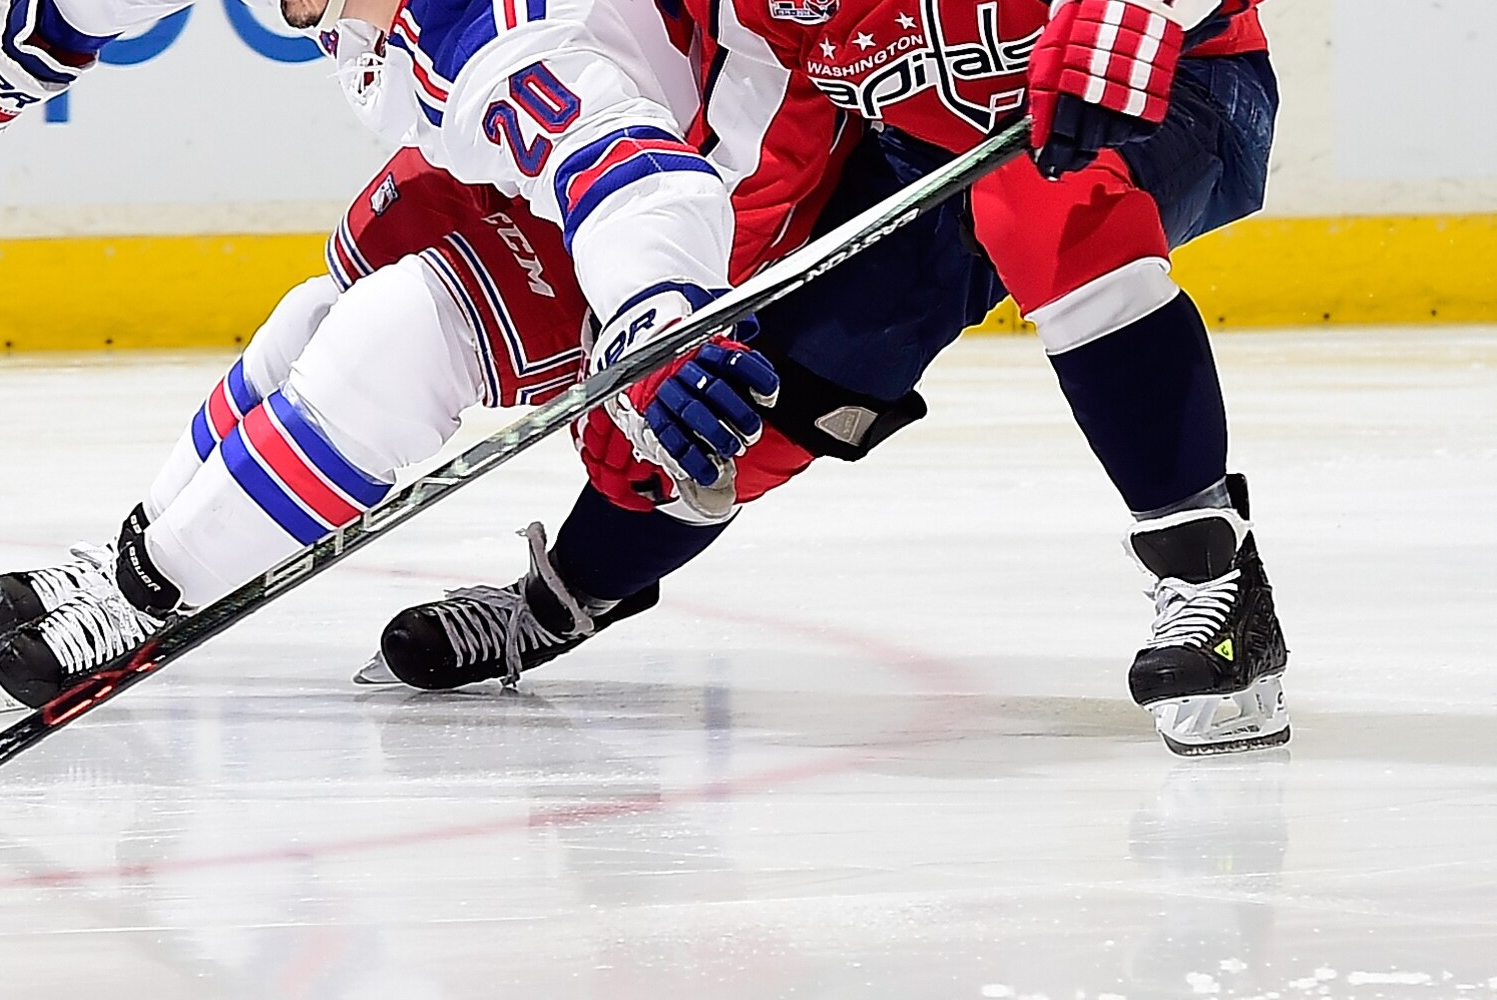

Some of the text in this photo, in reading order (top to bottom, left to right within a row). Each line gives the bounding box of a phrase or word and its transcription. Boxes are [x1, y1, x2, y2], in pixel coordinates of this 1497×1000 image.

[806, 33, 924, 78] WASHINGTON
[483, 59, 583, 178] 20
[481, 211, 556, 299] CCM
